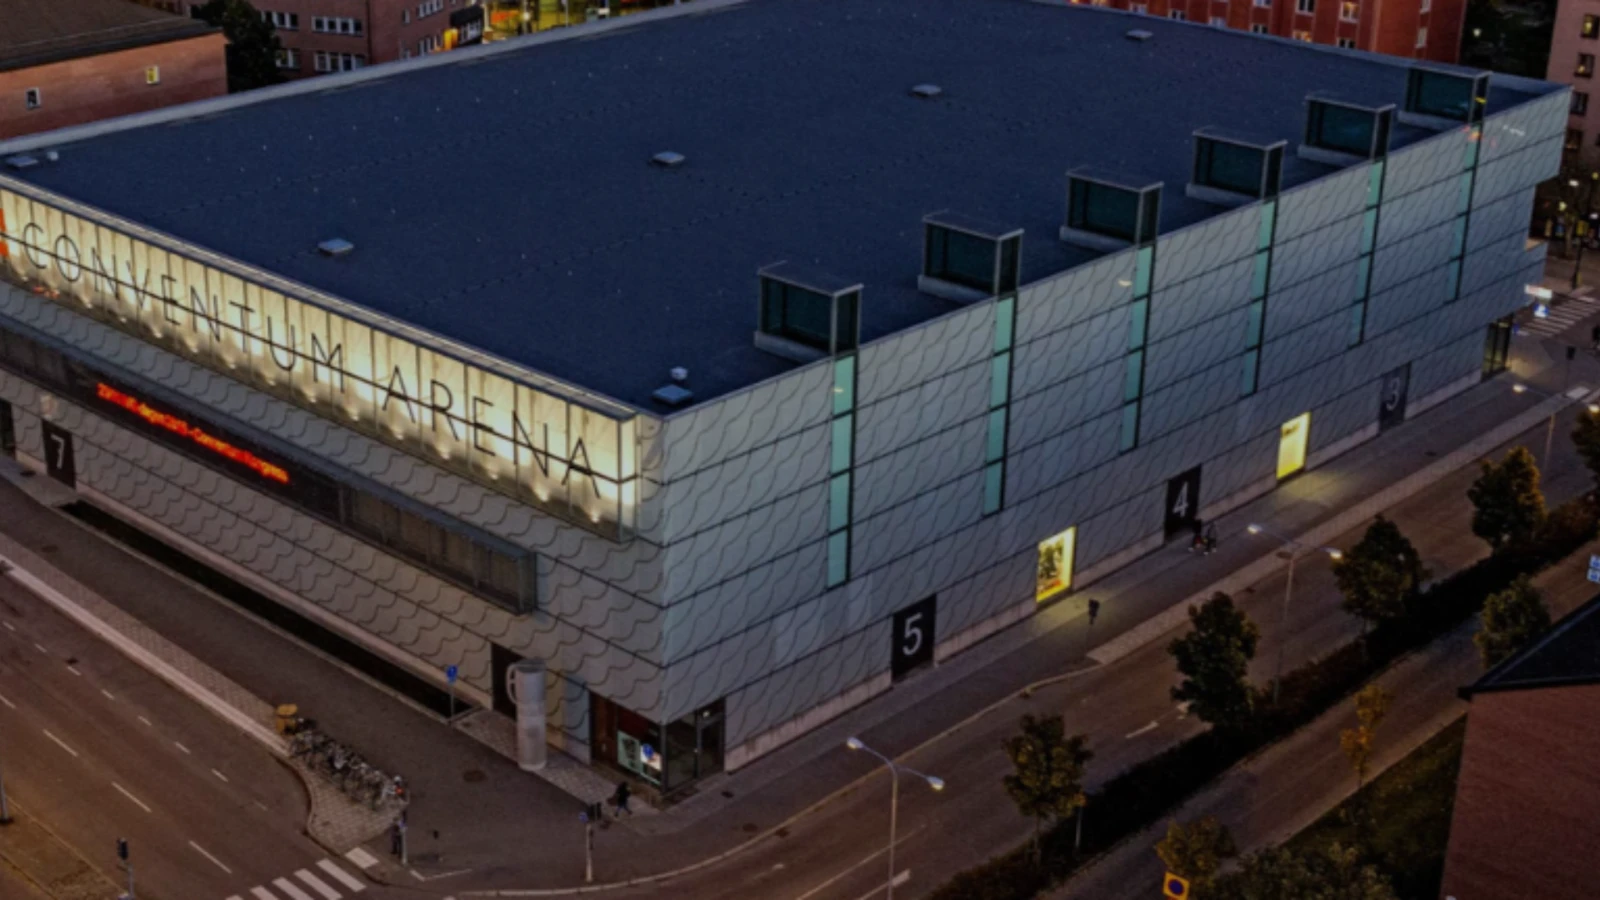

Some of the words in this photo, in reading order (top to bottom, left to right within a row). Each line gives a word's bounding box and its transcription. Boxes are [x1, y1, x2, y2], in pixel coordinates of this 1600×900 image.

[23, 222, 345, 393] CONVENTUM
[382, 365, 600, 499] ARENA
[1386, 376, 1401, 412] 3
[50, 432, 65, 470] 7
[1172, 480, 1189, 518] 4
[902, 611, 923, 656] 5
